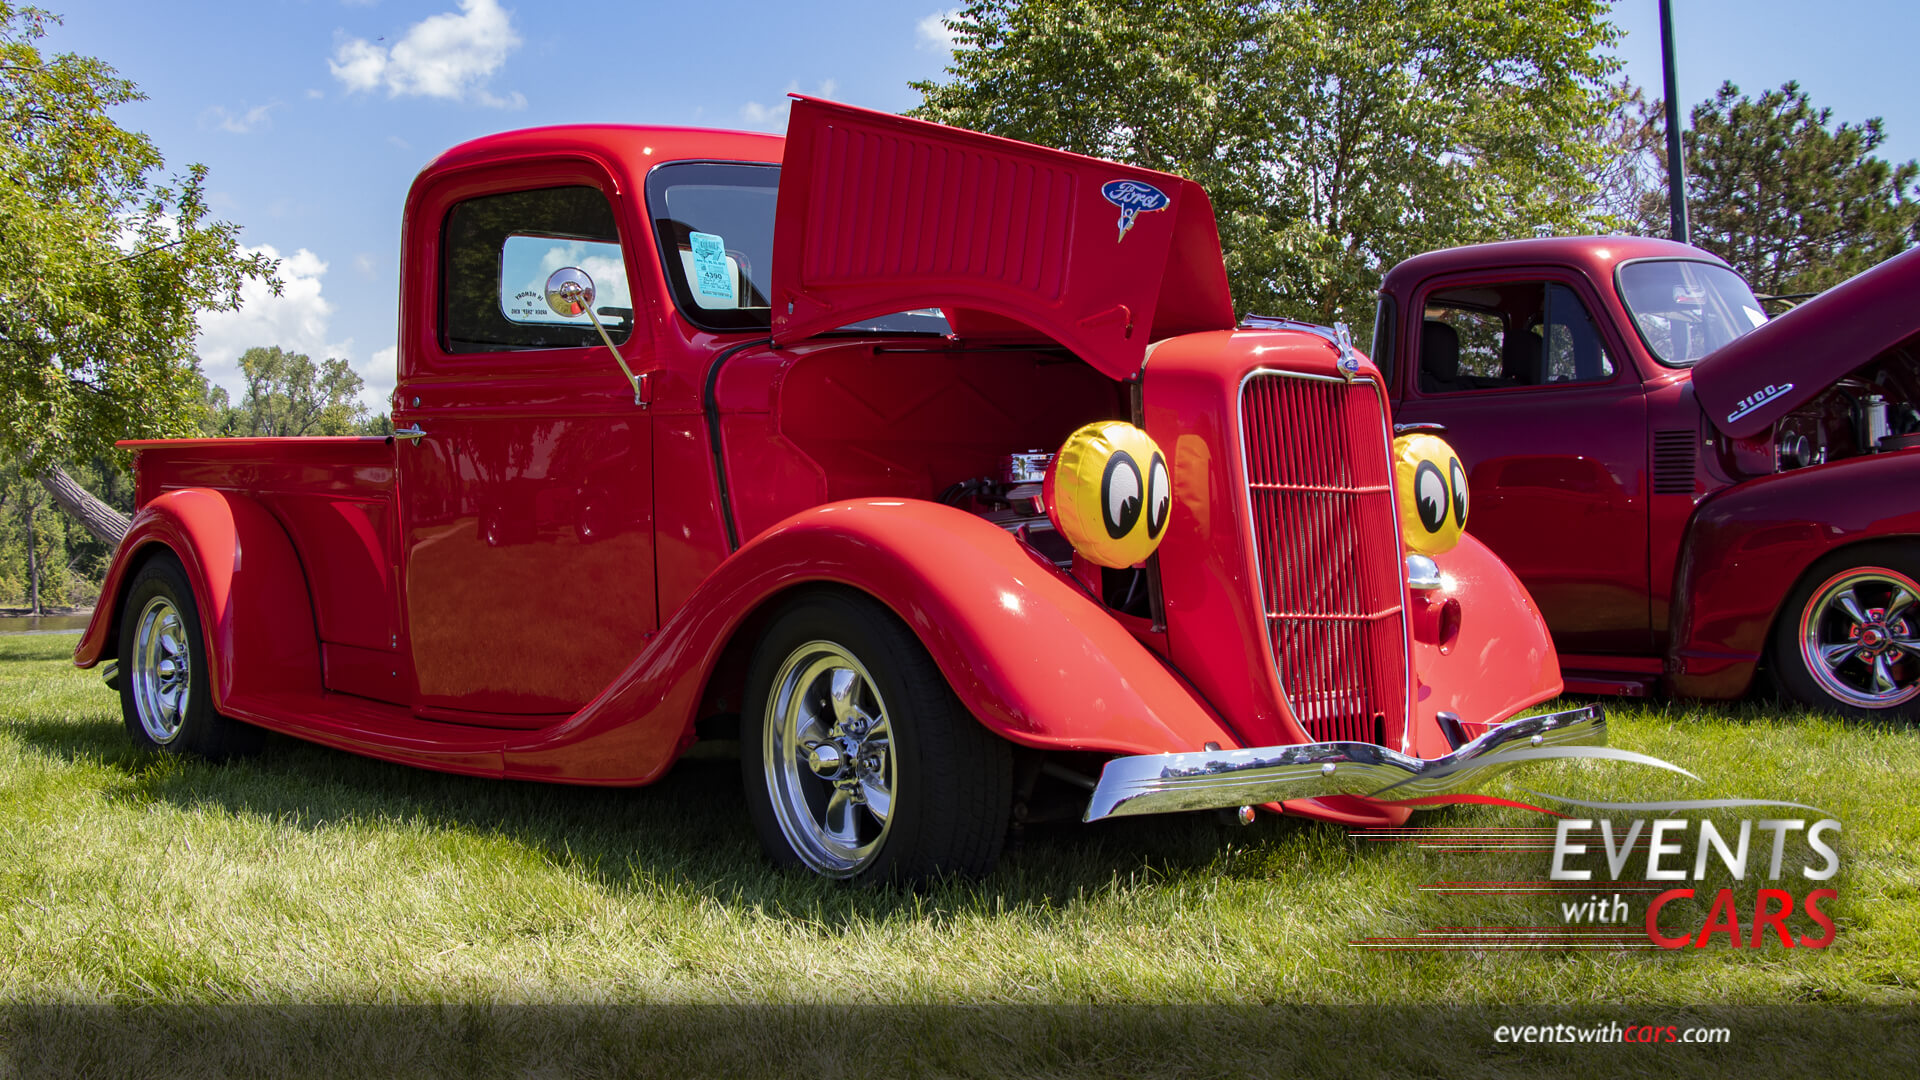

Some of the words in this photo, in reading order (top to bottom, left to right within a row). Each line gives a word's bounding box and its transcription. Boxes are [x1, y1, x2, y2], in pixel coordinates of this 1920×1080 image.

[1109, 182, 1160, 208] Ford
[704, 271, 723, 280] 4390
[1736, 384, 1777, 411] 3100
